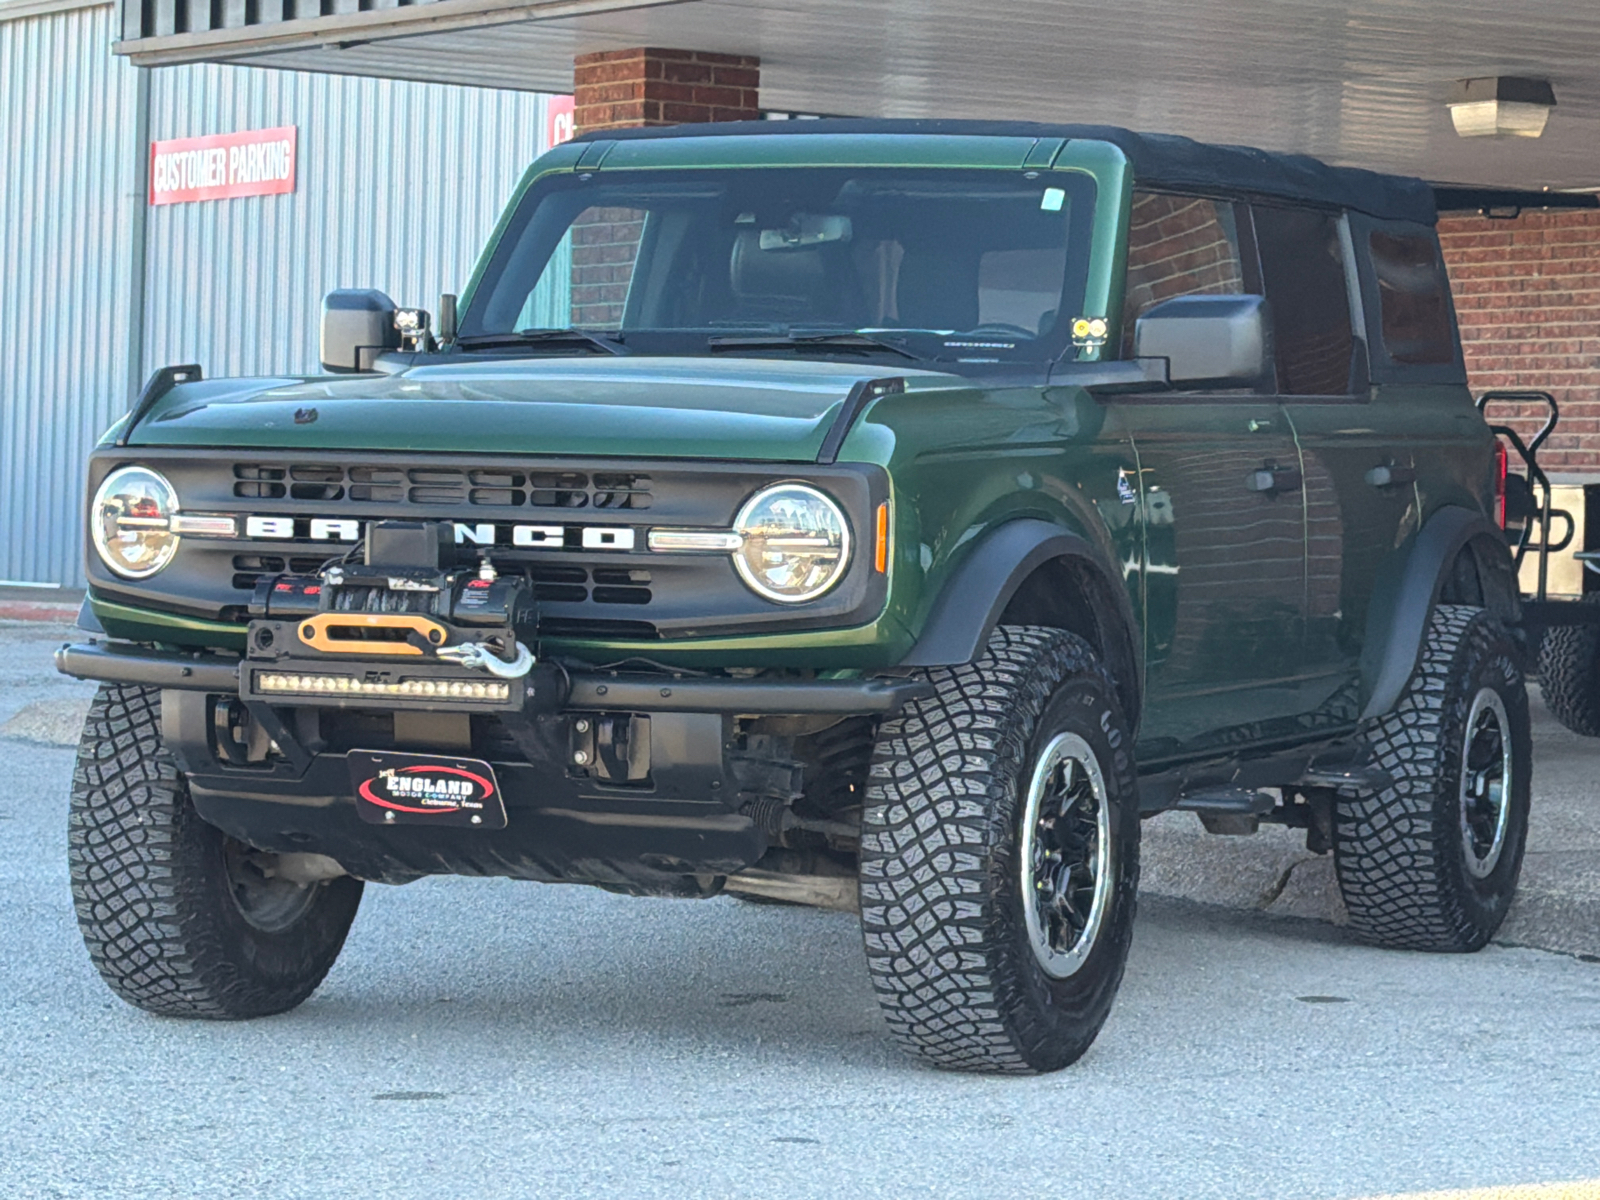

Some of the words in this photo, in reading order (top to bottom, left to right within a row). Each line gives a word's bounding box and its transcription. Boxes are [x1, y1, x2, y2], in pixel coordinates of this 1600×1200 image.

[154, 147, 226, 193] CUSTOMER
[229, 139, 290, 185] PARKING
[246, 516, 635, 549] BRNCO
[386, 776, 474, 796] ENGLAND
[392, 790, 422, 799] MOTOR
[425, 791, 467, 801] COMPANY
[461, 800, 484, 809] Texas
